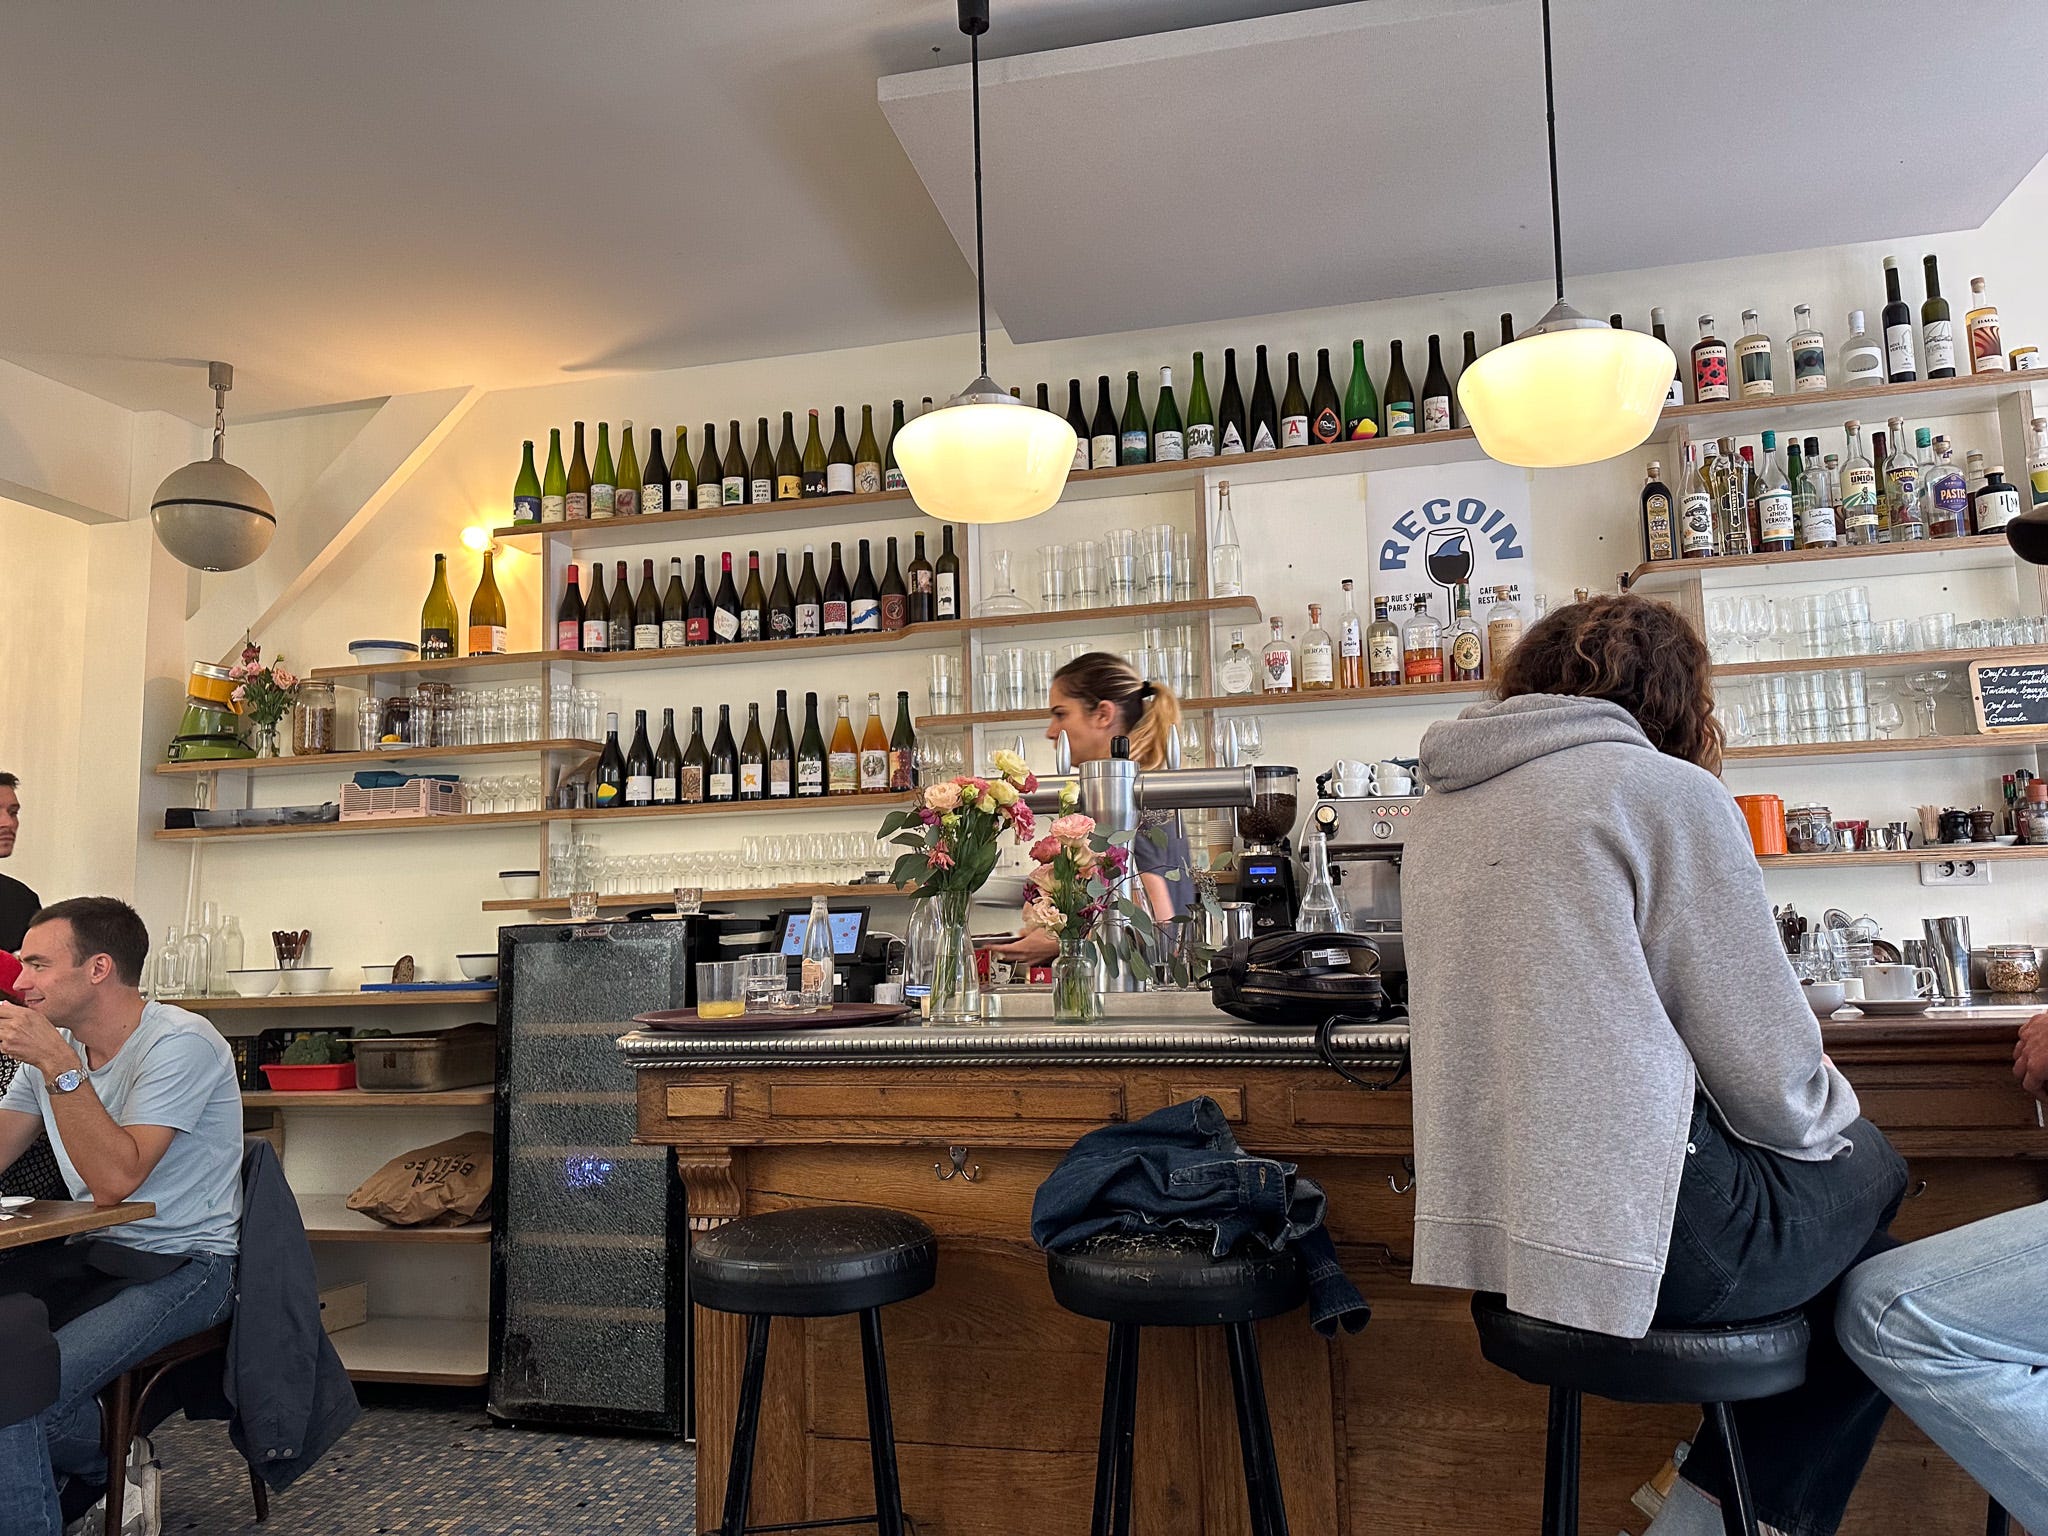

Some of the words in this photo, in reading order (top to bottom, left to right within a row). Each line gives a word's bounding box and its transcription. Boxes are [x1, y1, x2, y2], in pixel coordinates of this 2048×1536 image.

[1940, 488, 1966, 501] PASTIS
[1765, 516, 1791, 524] VERMOUTH
[1380, 498, 1524, 571] RECOIN
[1391, 594, 1404, 603] RUE
[1477, 593, 1521, 605] RESTANT
[1388, 603, 1407, 612] PARIS
